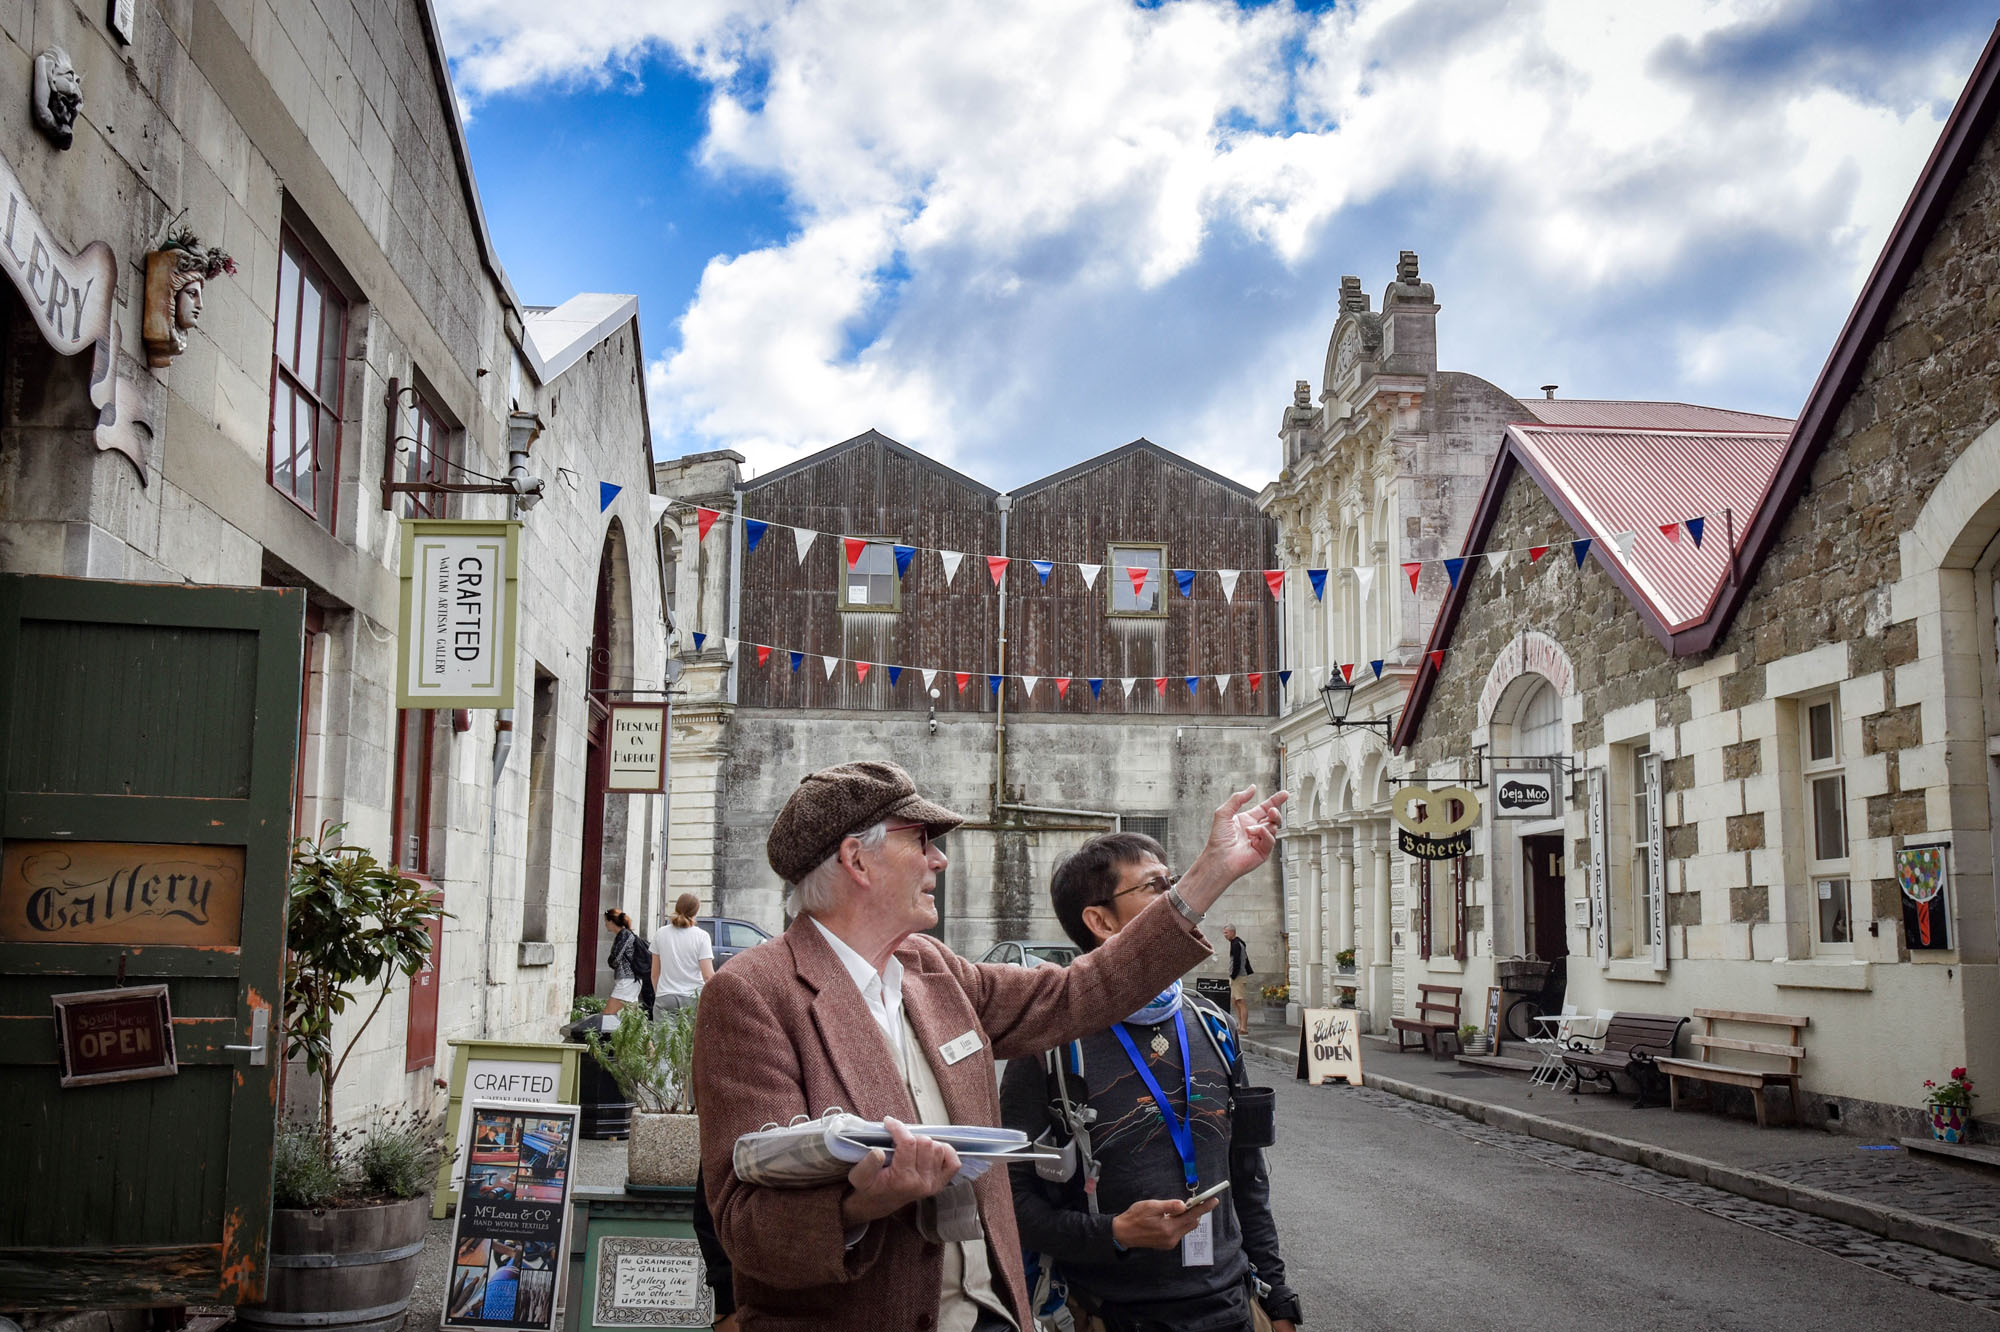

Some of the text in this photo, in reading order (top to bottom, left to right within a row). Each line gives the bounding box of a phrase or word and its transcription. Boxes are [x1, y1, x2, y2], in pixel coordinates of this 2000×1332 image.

[0, 192, 94, 343] LERY
[434, 556, 451, 675] WAITAKI ARTISAN GALLERY
[615, 719, 661, 732] PRESENCE
[630, 735, 644, 746] ON
[614, 750, 657, 763] HARBOUR
[1501, 788, 1548, 804] Deja Moo
[1403, 835, 1467, 859] Bakery
[26, 864, 213, 932] Gallery
[1313, 1016, 1350, 1045] Bakery
[80, 1027, 151, 1059] OPEN
[1314, 1044, 1353, 1062] OPEN
[474, 1073, 553, 1093] CRAFTED
[474, 1205, 518, 1220] McLean
[520, 1209, 534, 1221] &
[473, 1219, 549, 1230] HAND WOVEN TEXTILES
[636, 1257, 693, 1266] GRAINSTORE
[638, 1265, 680, 1274] GALLERY
[631, 1276, 667, 1291] gallery
[670, 1276, 687, 1286] like
